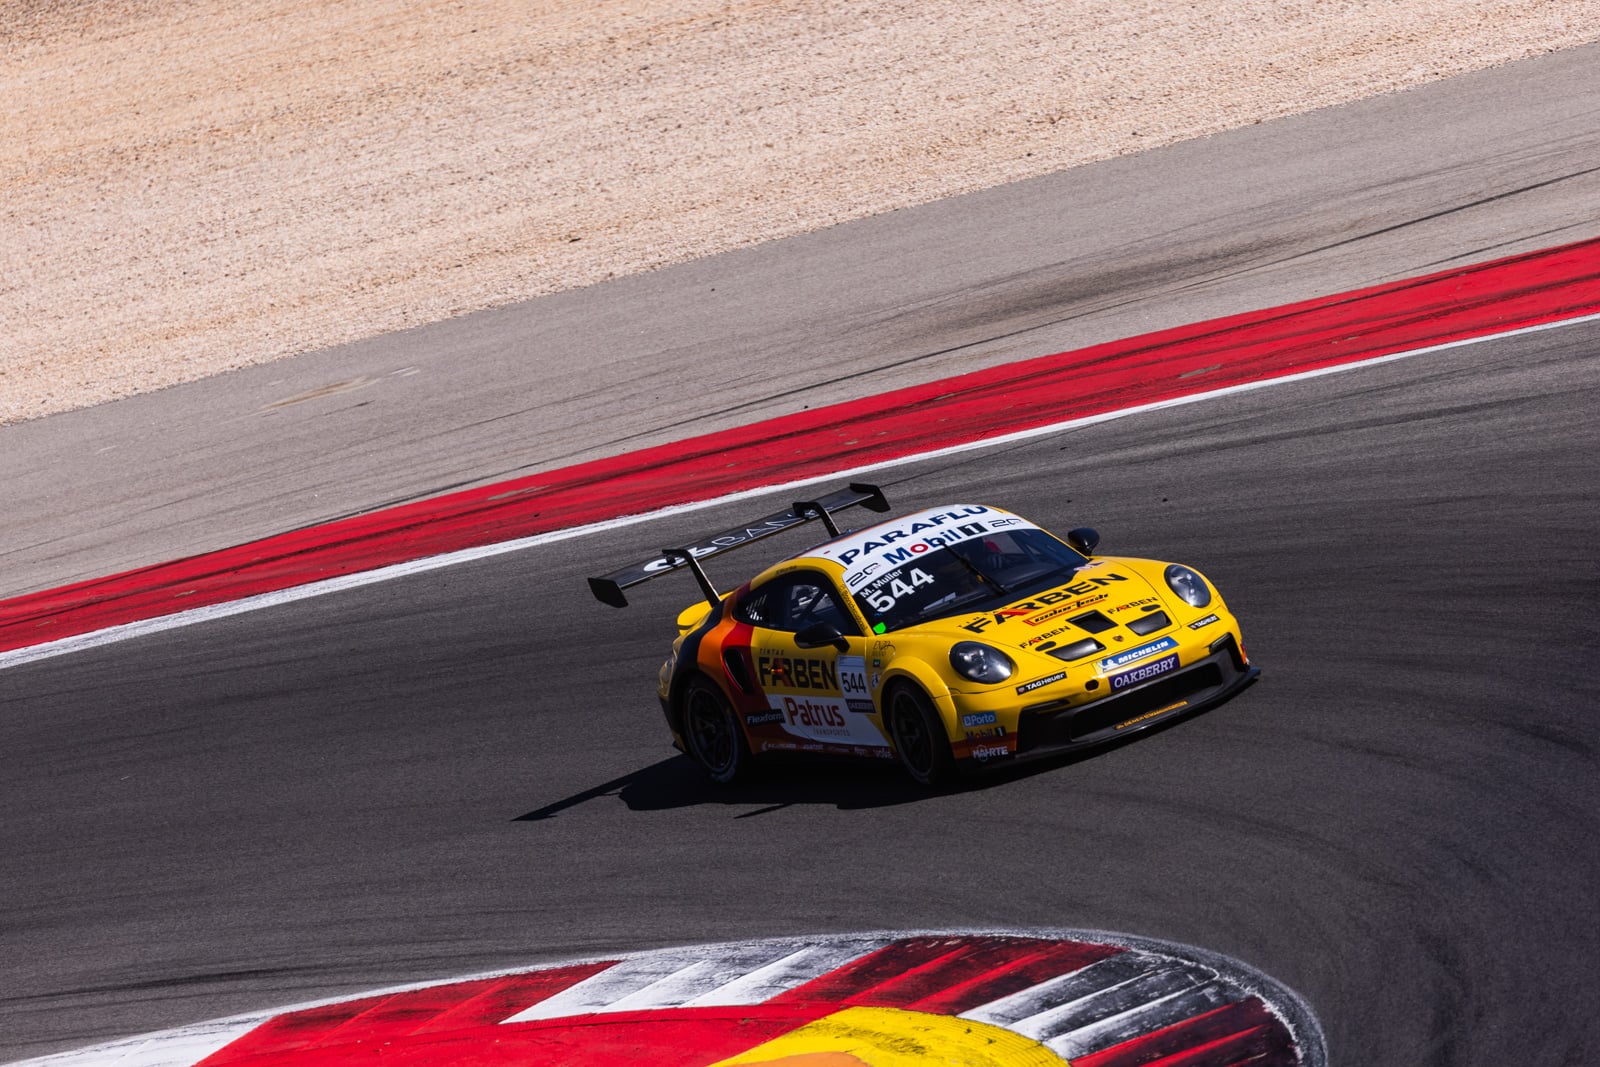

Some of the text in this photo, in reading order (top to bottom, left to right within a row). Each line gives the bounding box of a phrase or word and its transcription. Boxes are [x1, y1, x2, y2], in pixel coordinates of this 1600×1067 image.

[838, 506, 988, 565] PARAFLU
[882, 529, 963, 565] Mobil
[859, 584, 875, 599] M.
[865, 567, 935, 613] 544
[963, 573, 1129, 633] FARBEN
[1106, 596, 1158, 614] FARBEN
[1018, 625, 1072, 649] FARBEN
[1118, 641, 1170, 664] MICHELIN
[758, 657, 839, 690] FARBEN
[841, 672, 866, 693] 544
[1113, 657, 1176, 688] OAKBERRY
[784, 697, 846, 727] Patrus
[972, 713, 996, 725] Porto
